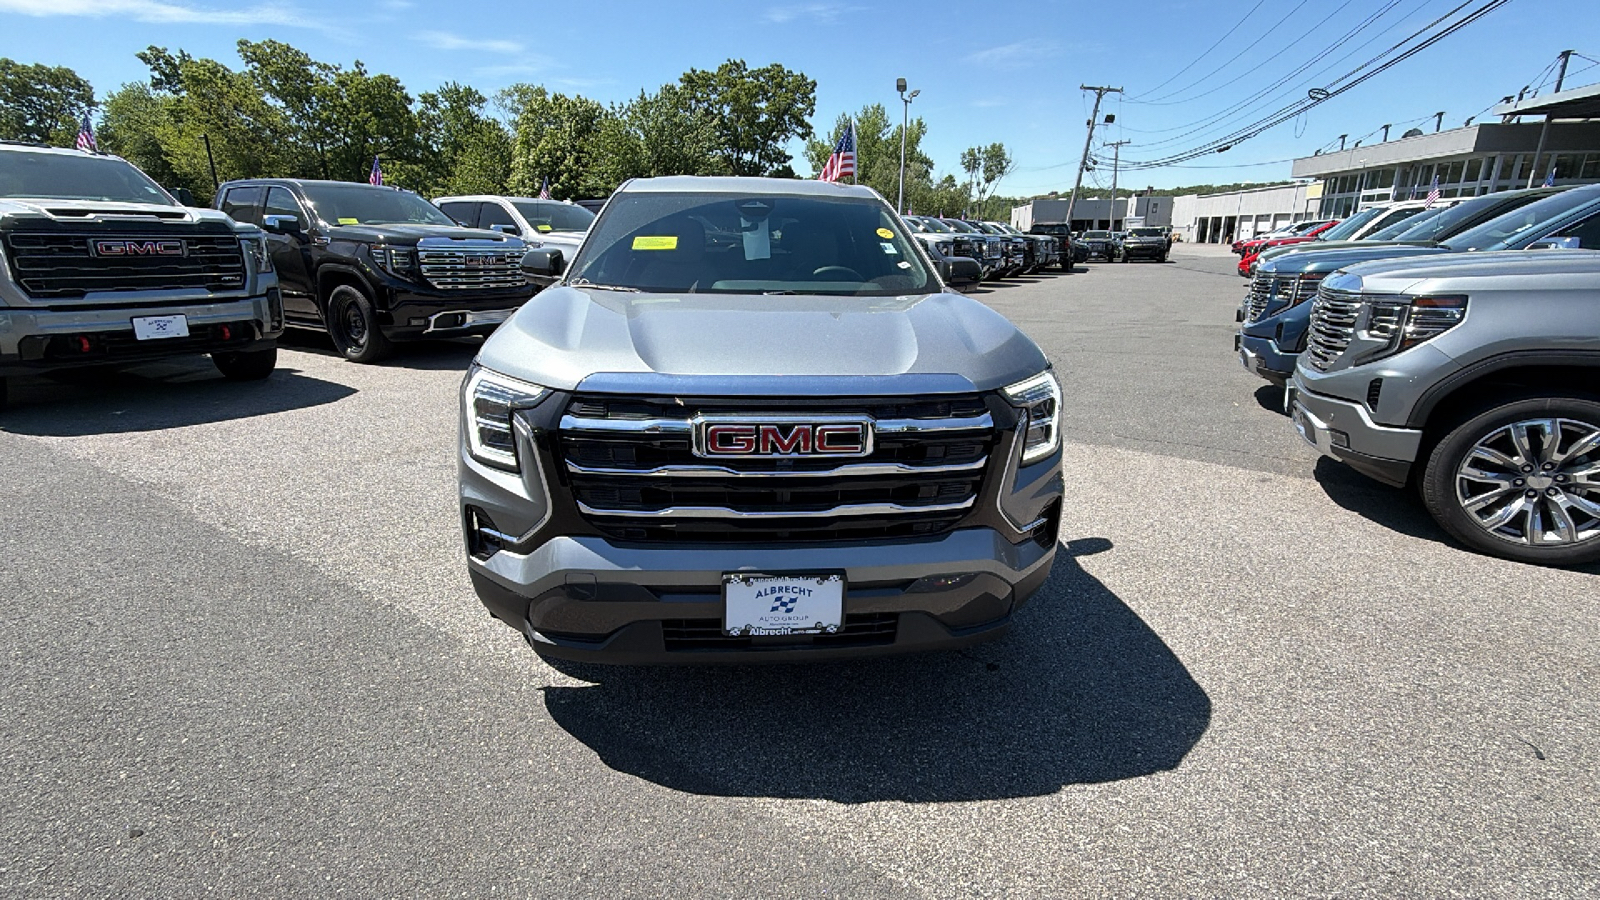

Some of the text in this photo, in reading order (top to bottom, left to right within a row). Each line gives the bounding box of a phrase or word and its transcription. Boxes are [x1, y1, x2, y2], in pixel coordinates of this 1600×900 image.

[97, 241, 182, 255] GMC
[466, 256, 506, 265] GMC
[707, 424, 863, 454] GMC
[755, 585, 813, 599] ALBRECHT
[749, 627, 792, 636] Albrecht
